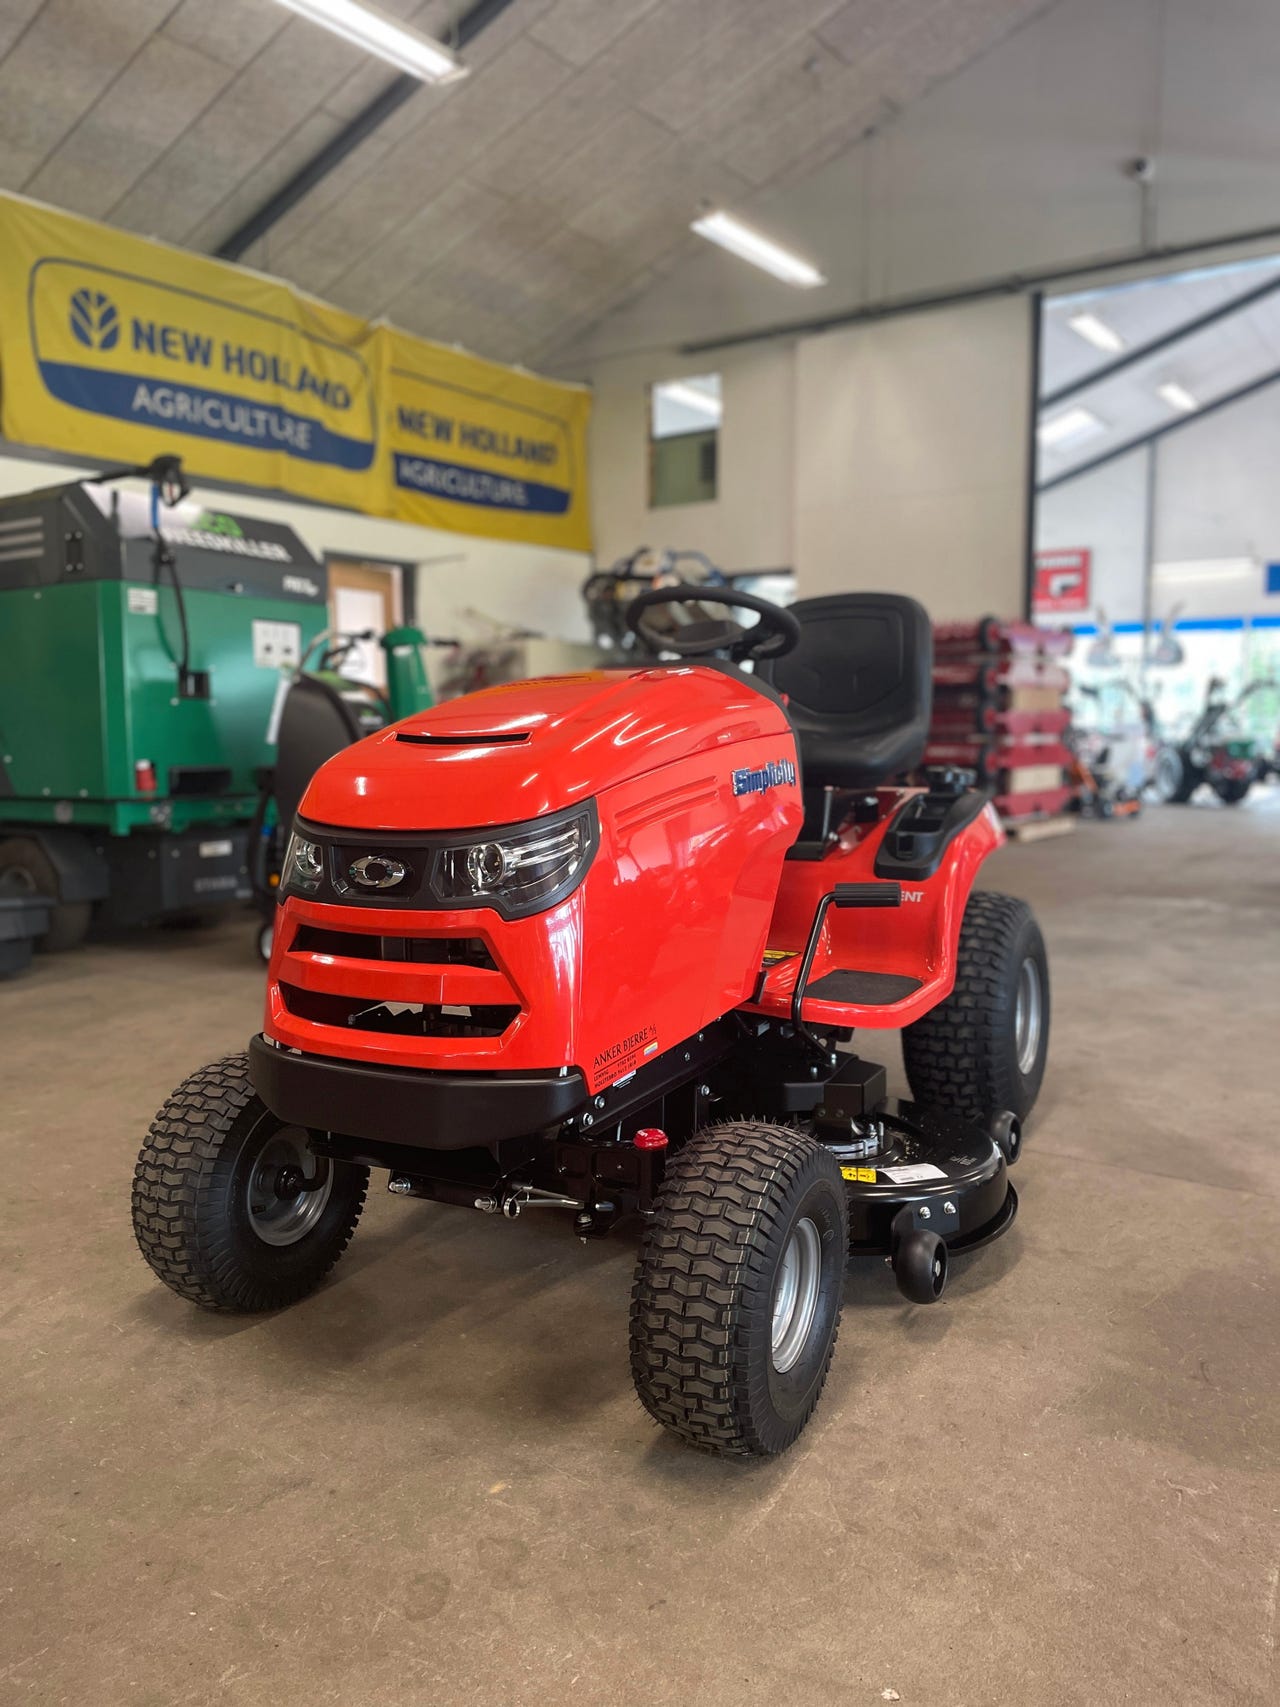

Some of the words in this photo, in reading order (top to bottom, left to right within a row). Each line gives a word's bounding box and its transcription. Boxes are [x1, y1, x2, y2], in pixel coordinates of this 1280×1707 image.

[132, 317, 212, 367] NEW
[223, 342, 352, 410] HOLLAND
[131, 383, 312, 450] AGRICULTURE
[397, 406, 454, 443] NEW
[459, 421, 559, 466] HOLLAND
[399, 458, 529, 506] AGRICULTURE
[731, 758, 797, 797] Simplicity
[900, 890, 924, 903] ENT
[593, 1043, 622, 1070] ANKER
[623, 1027, 649, 1053] BJERRE
